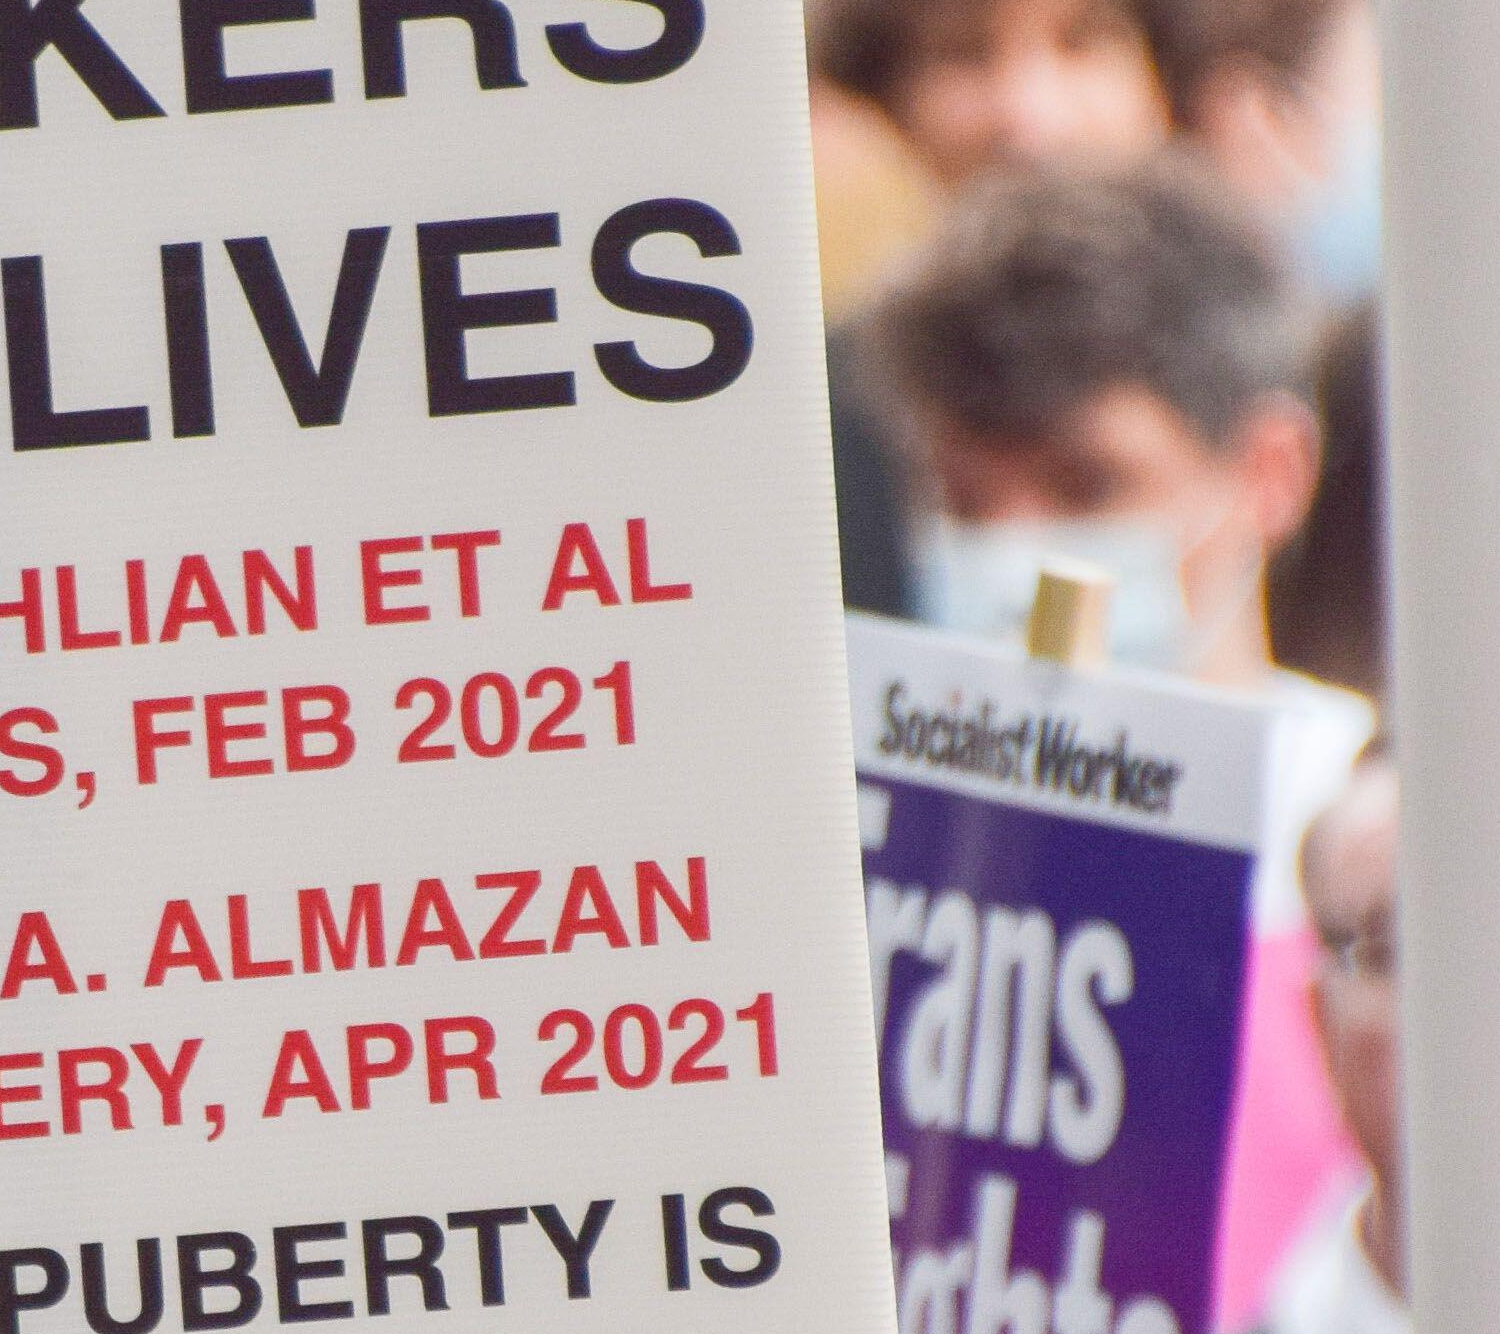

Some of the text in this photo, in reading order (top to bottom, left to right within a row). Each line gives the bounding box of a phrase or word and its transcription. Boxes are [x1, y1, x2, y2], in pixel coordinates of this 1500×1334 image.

[0, 196, 755, 454] LIVES
[358, 528, 502, 627] ET
[540, 516, 694, 612] AL
[131, 683, 357, 786] FEB
[393, 659, 637, 765] 2021
[1034, 715, 1183, 812] Worker
[142, 855, 712, 989] ALMAZAN
[857, 782, 1136, 1166] rans
[261, 1014, 502, 1119] APR
[536, 991, 779, 1096] 2021
[659, 1185, 784, 1293] IS
